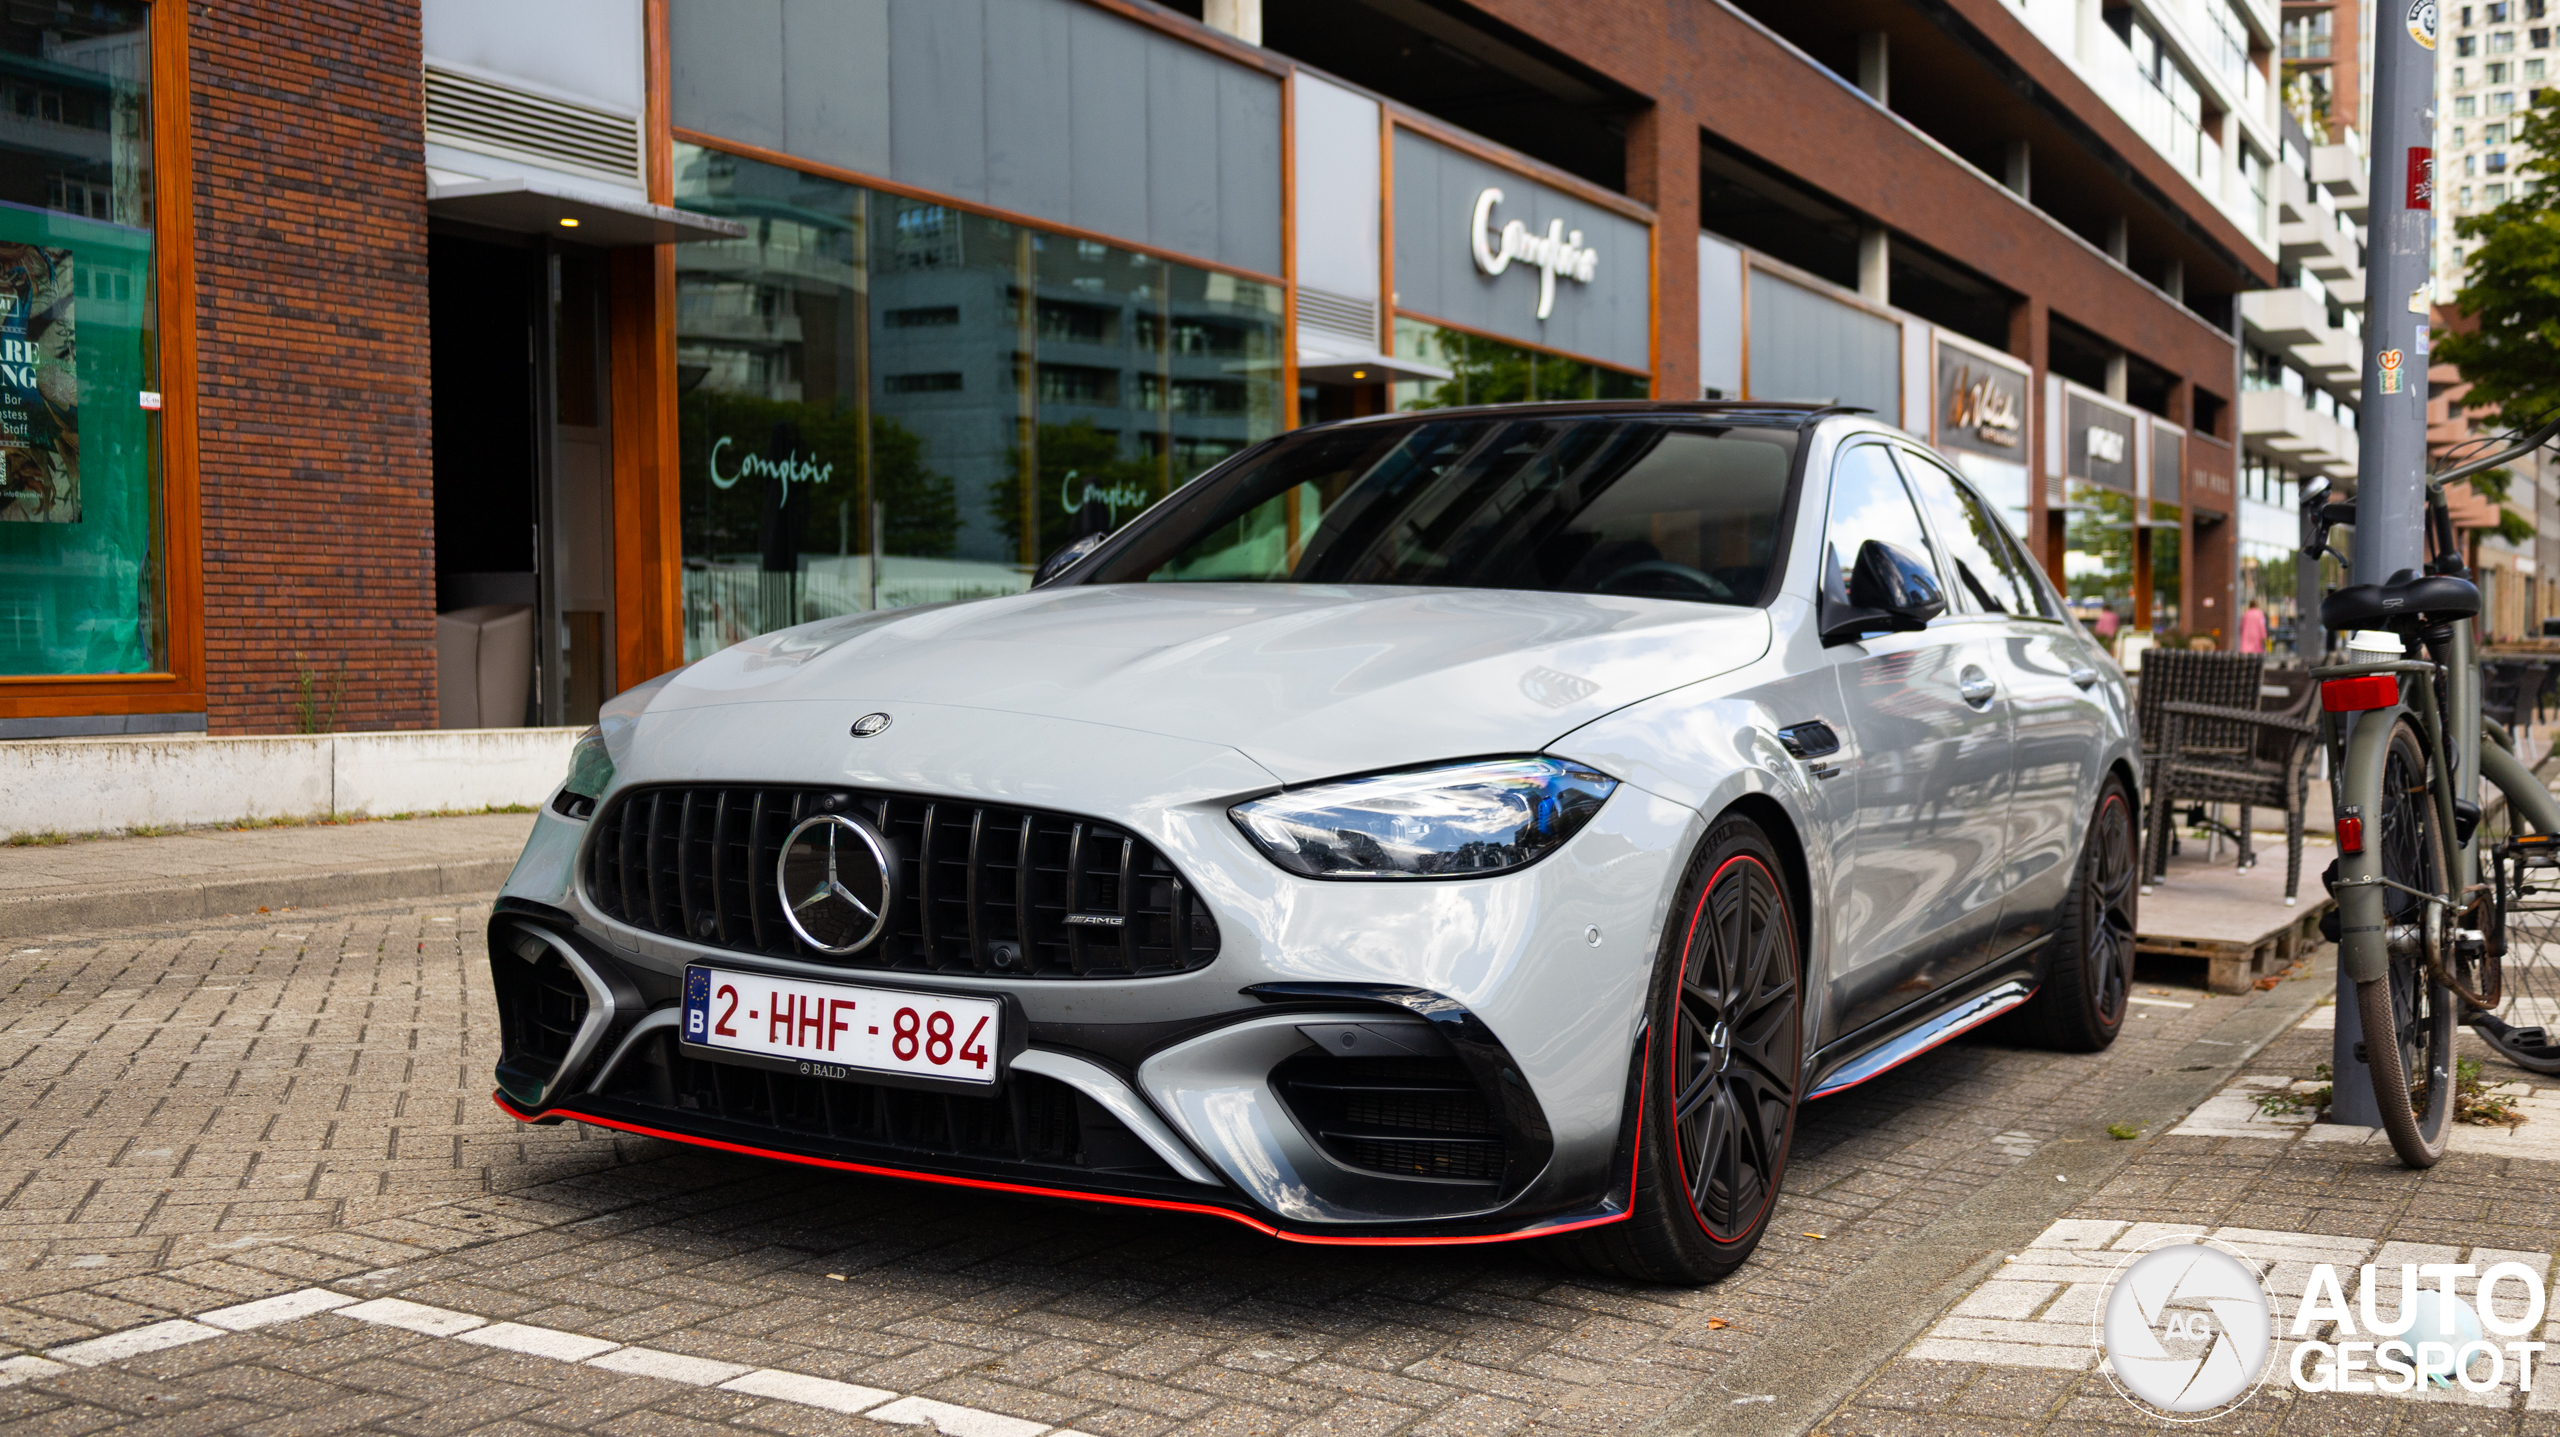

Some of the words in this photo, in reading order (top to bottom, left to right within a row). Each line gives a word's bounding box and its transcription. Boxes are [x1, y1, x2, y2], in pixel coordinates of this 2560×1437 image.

[0, 364, 37, 389] NG
[4, 393, 22, 405] Bar
[3, 422, 28, 435] Staff
[710, 435, 834, 510] Comptoir
[1061, 469, 1149, 526] Comptoir
[688, 1008, 704, 1034] B
[812, 1063, 847, 1080] BALD
